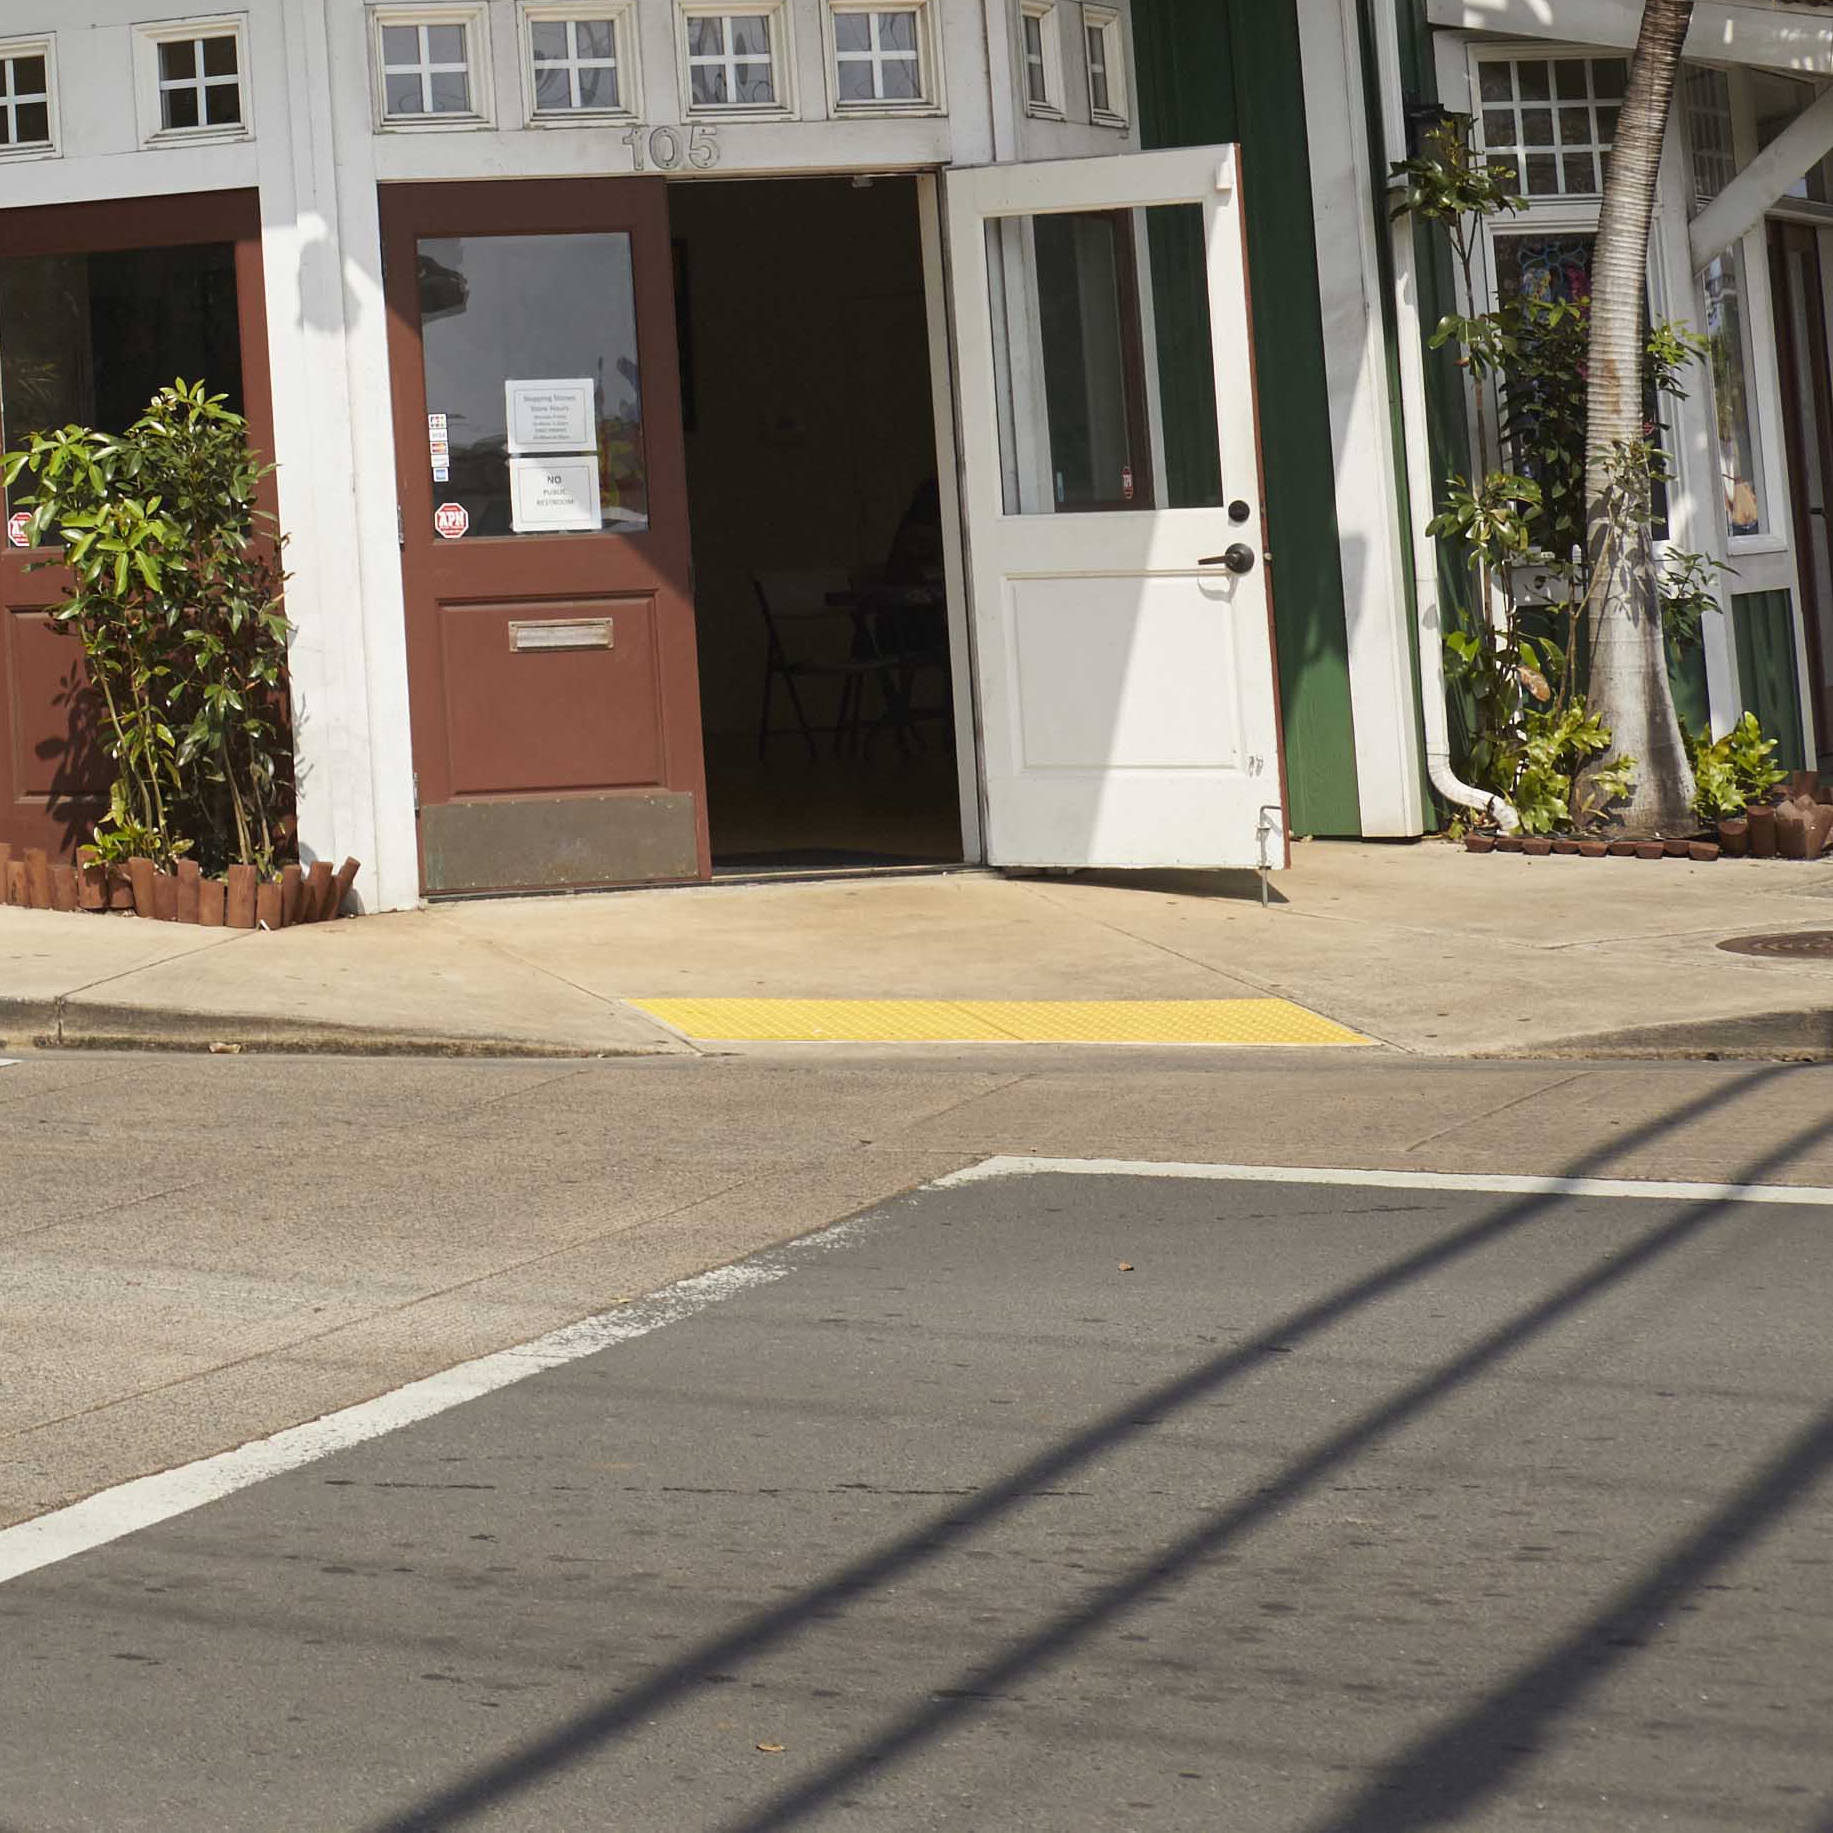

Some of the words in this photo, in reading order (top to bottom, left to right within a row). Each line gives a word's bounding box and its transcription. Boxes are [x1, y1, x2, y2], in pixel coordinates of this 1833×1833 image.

[621, 125, 720, 171] 105
[547, 475, 562, 484] NO
[438, 511, 464, 527] APN
